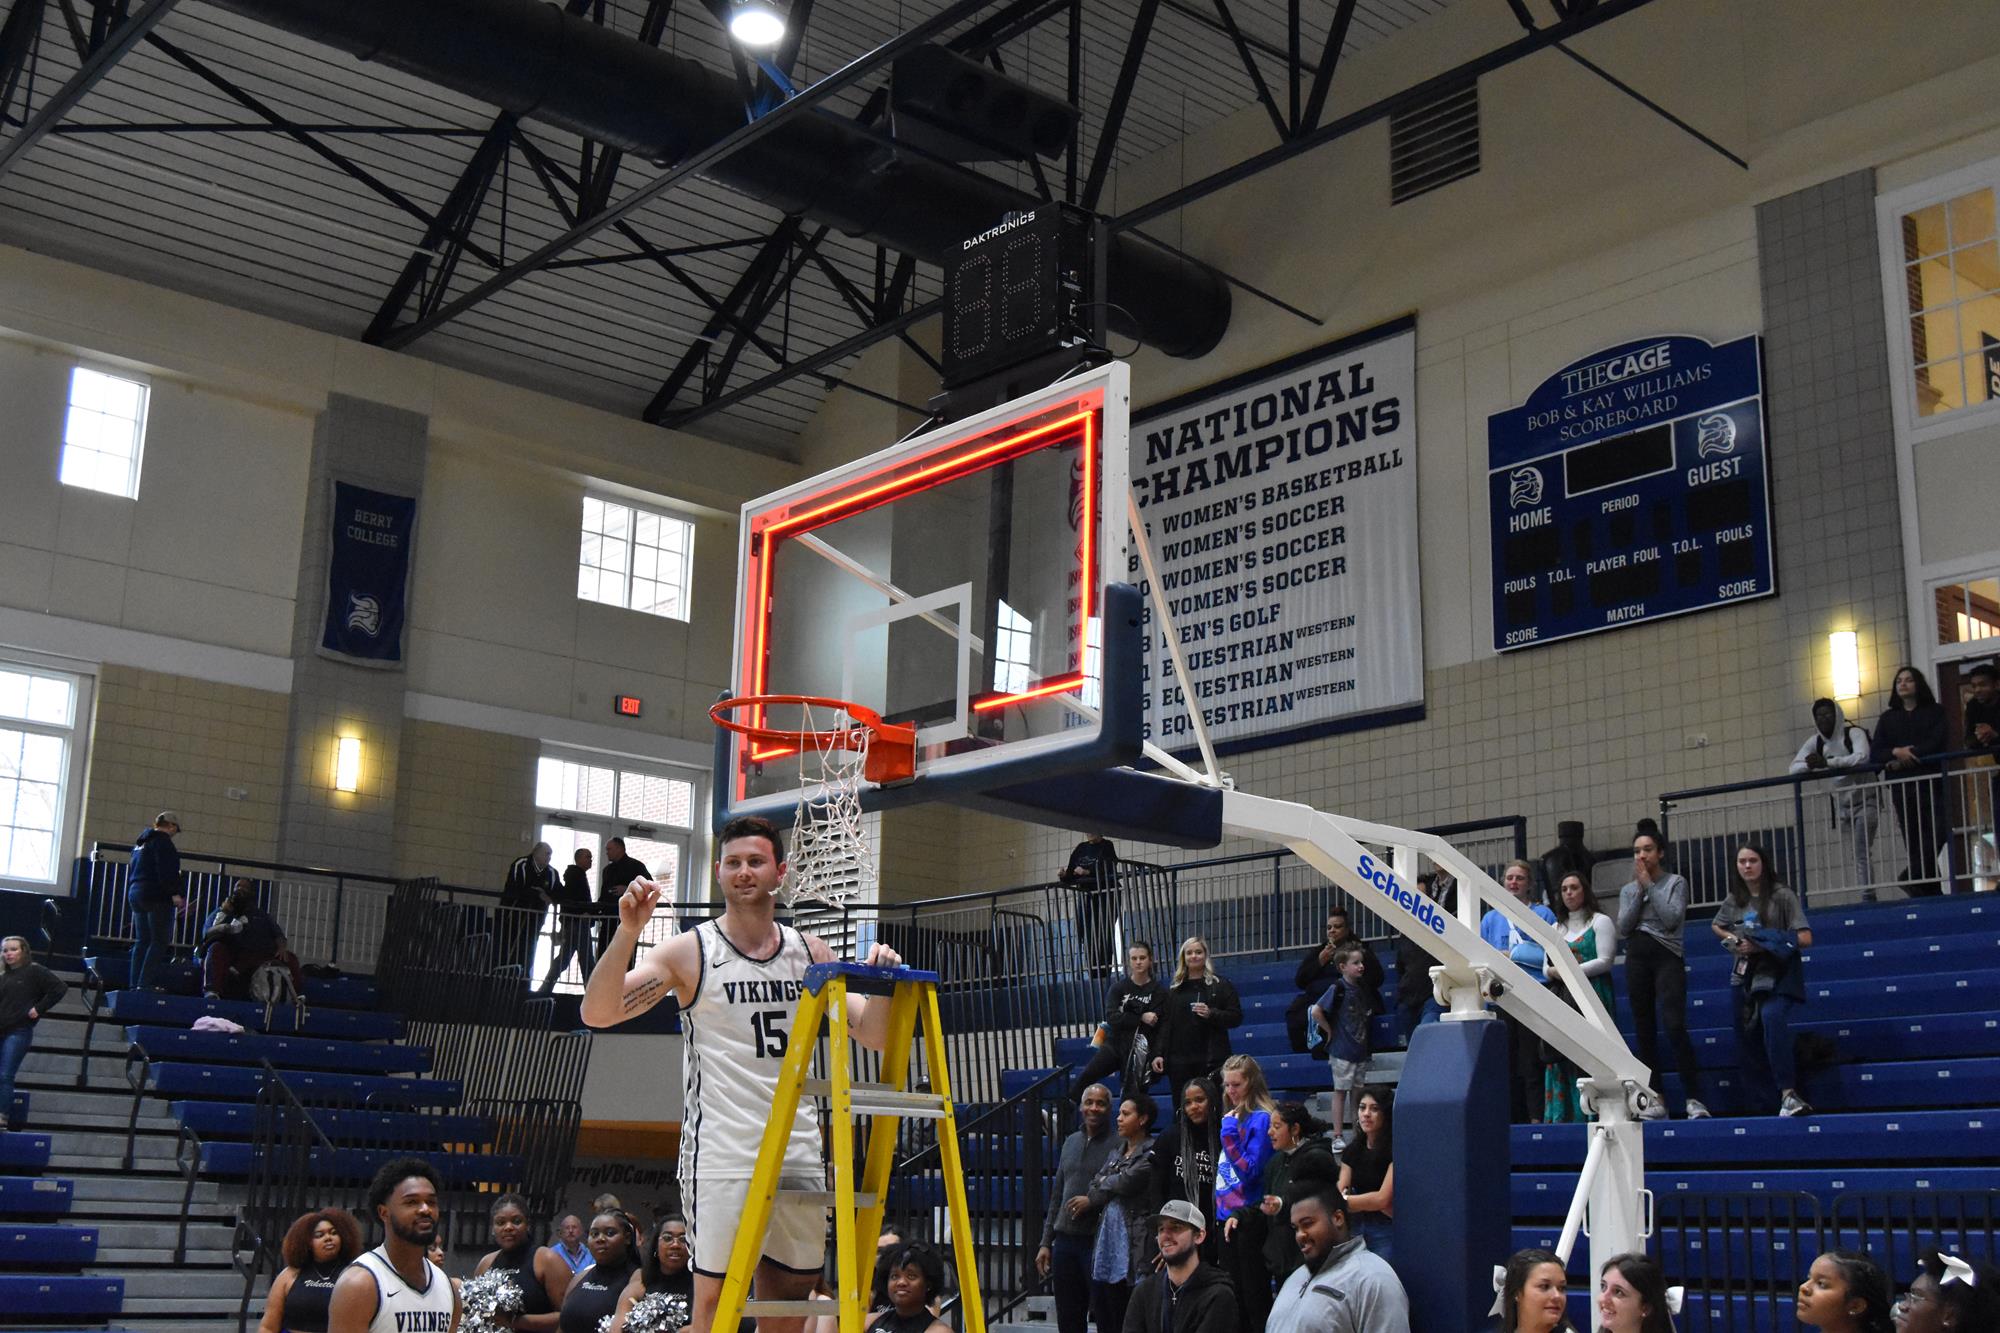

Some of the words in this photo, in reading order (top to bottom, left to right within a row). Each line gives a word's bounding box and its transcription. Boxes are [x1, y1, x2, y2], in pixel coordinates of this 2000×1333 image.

[963, 211, 1036, 250] DAKTRONICS
[1528, 409, 1560, 432] BOB
[1564, 405, 1578, 420] &
[1583, 392, 1615, 415] KAY
[1623, 363, 1712, 402] WILLIAMS
[1146, 362, 1374, 466] NATIONAL
[1560, 395, 1678, 441] SCOREBOARD
[1687, 456, 1742, 487] GUEST
[1162, 492, 1257, 535] WOMEN'S
[1262, 448, 1403, 506] BASKETBALL
[1601, 494, 1640, 515] PERIOD
[354, 509, 393, 529] BERRY
[1162, 521, 1257, 563] WOMEN'S
[1262, 495, 1345, 536] SOCCER
[1509, 506, 1552, 533] HOME
[347, 526, 398, 547] COLLEGE
[1161, 551, 1257, 592] WOMEN'S
[1262, 525, 1346, 566] SOCCER
[1503, 575, 1537, 595] FOULS
[1547, 568, 1576, 585] T.O.L.
[1586, 554, 1627, 576] PLAYER
[1633, 547, 1661, 565] FOUL
[1671, 538, 1702, 555] T.O.L.
[1715, 525, 1753, 545] FOULS
[1262, 556, 1346, 594] SOCCER
[1718, 579, 1757, 599] SCORE
[1229, 603, 1281, 632] GOLF
[1607, 603, 1645, 624] MATCH
[1162, 631, 1294, 677] EUESTRIAN
[1296, 615, 1356, 639] WESTERN
[1505, 626, 1539, 645] SCORE
[1295, 648, 1355, 670] WESTERN
[1295, 679, 1355, 701] WESTERN
[1357, 854, 1445, 935] Schelde
[723, 980, 803, 1004] VIKINGS
[750, 1010, 788, 1058] 15
[394, 1311, 451, 1333] VIKINGS
